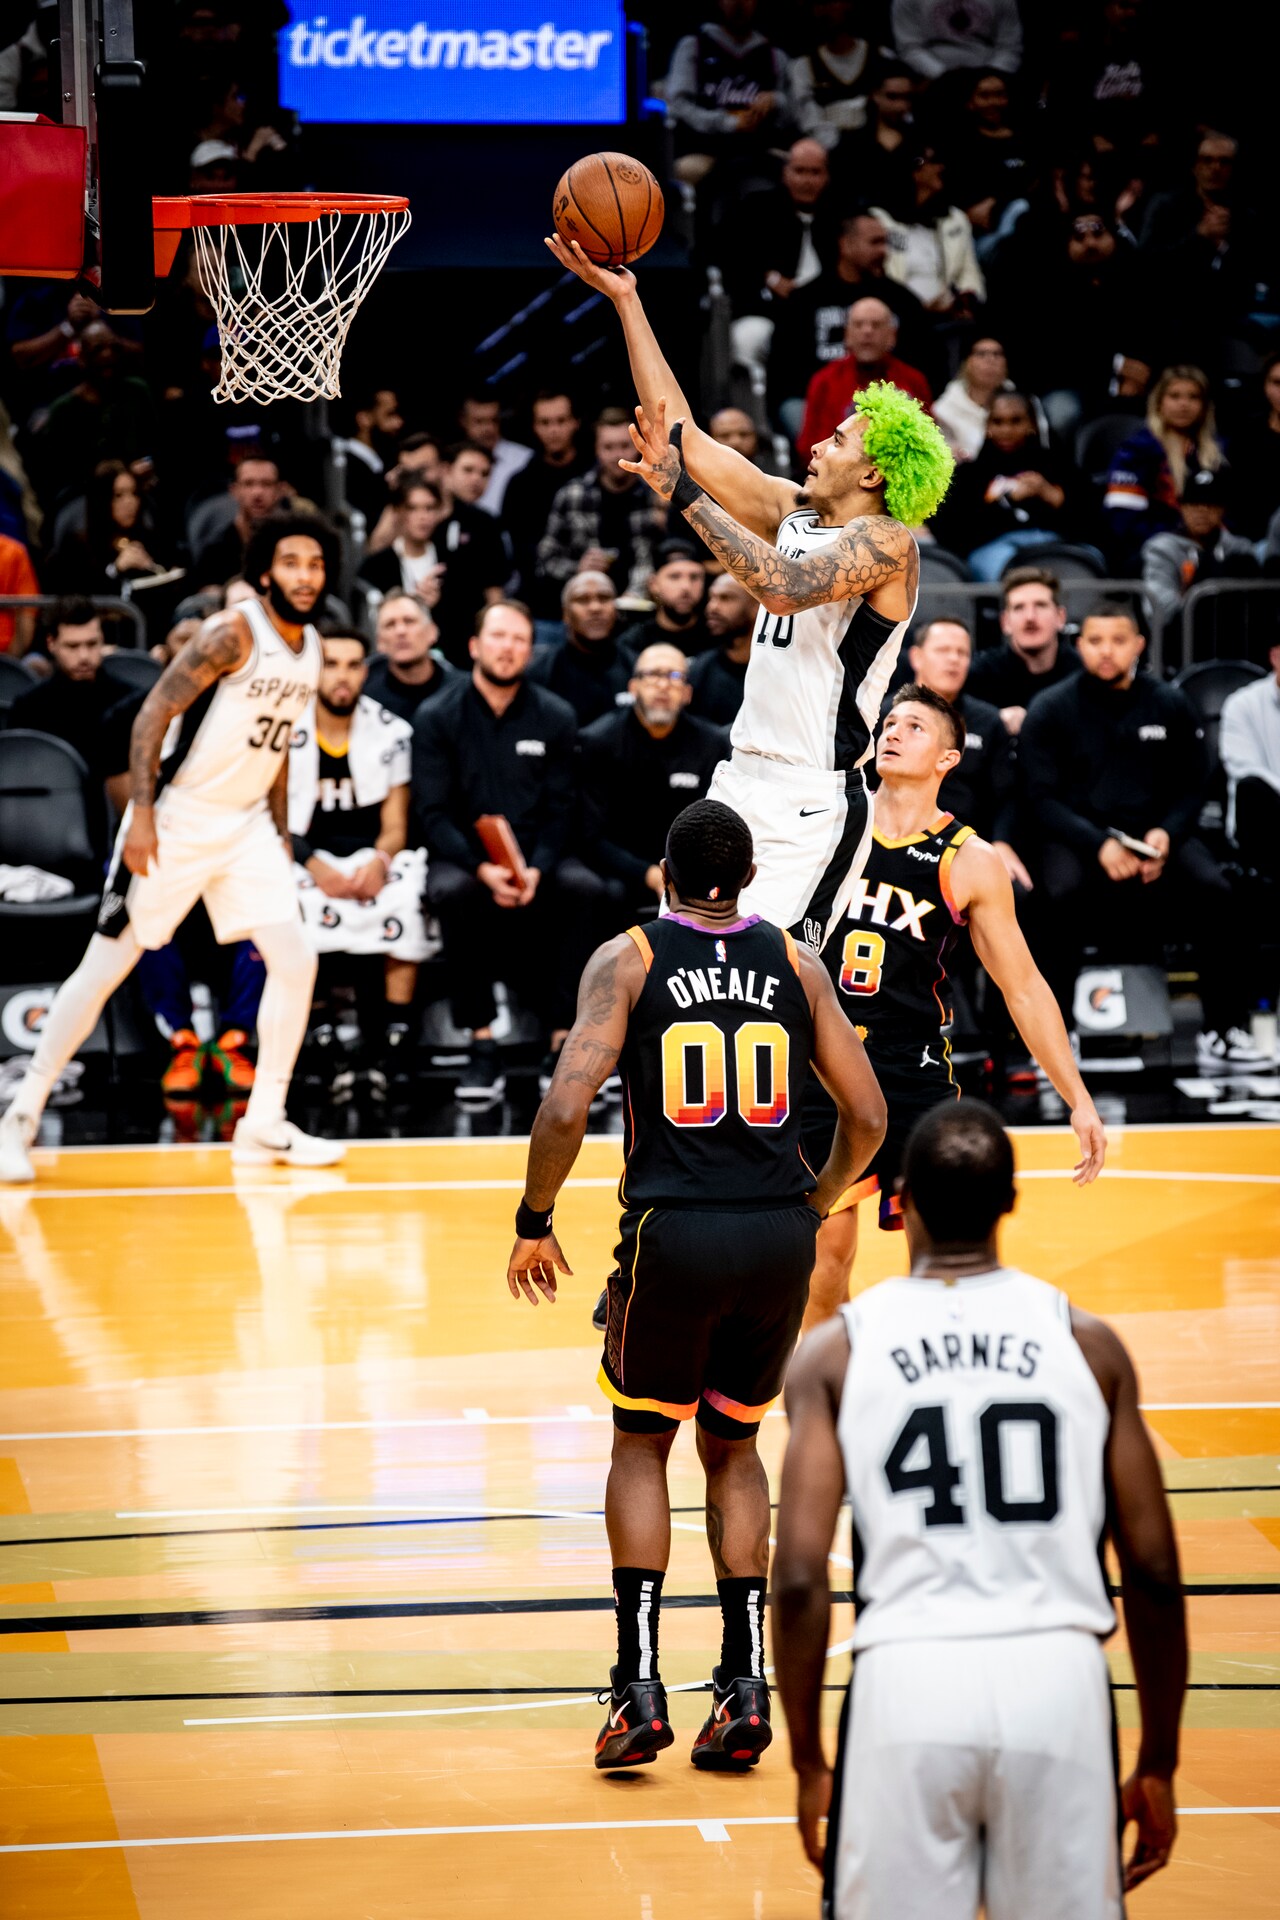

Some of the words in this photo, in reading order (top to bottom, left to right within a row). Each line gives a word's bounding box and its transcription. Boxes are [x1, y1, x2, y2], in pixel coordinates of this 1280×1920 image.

[287, 16, 612, 69] ticketmaster
[248, 716, 292, 752] 30
[906, 845, 941, 864] PayPal
[847, 877, 936, 942] HX
[666, 967, 780, 1011] O'NEALE
[838, 929, 886, 997] 8
[661, 1021, 790, 1128] 00
[891, 1333, 1041, 1384] BARNES
[882, 1400, 1062, 1529] 40
